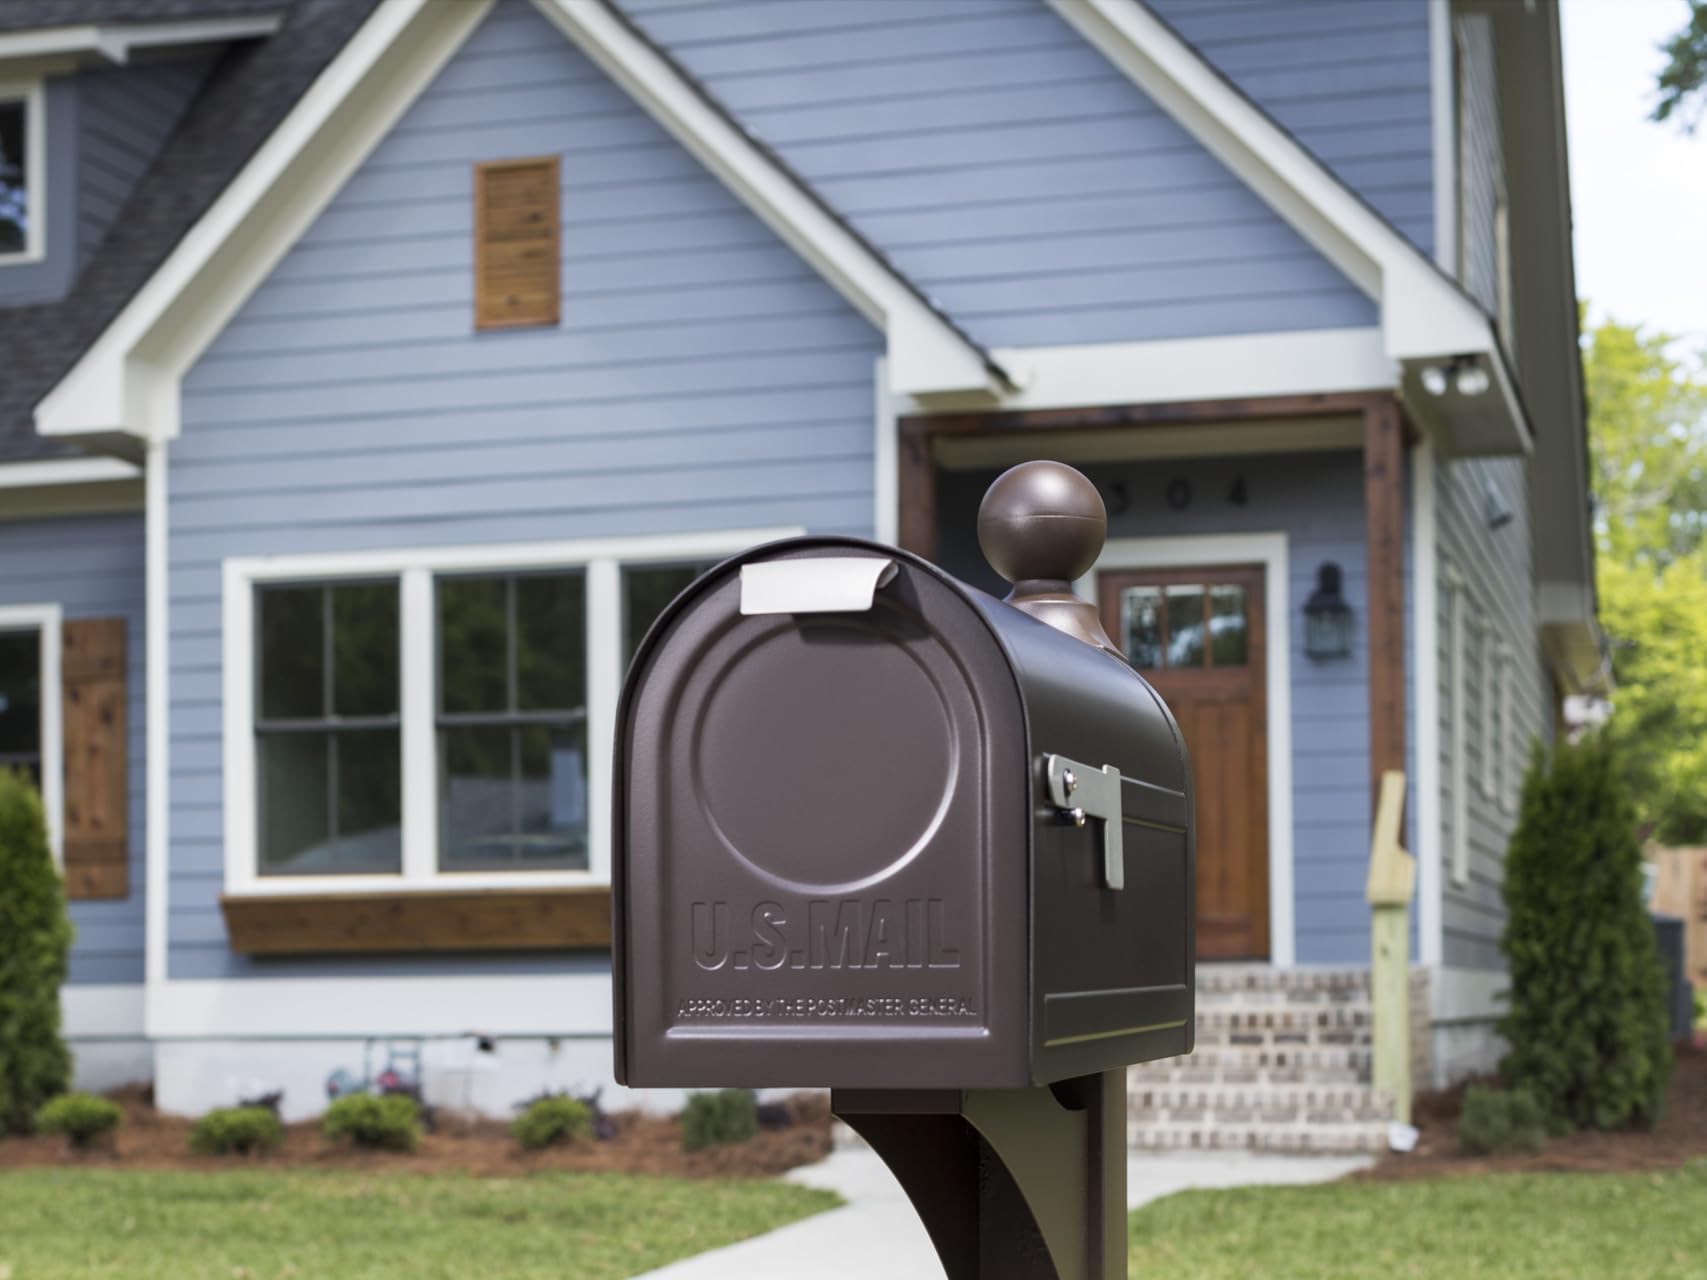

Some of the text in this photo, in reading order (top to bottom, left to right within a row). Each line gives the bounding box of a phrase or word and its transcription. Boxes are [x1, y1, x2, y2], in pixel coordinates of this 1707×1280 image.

[677, 998, 977, 1017] APPROVED BY THE POSTMASTER GENERAL
